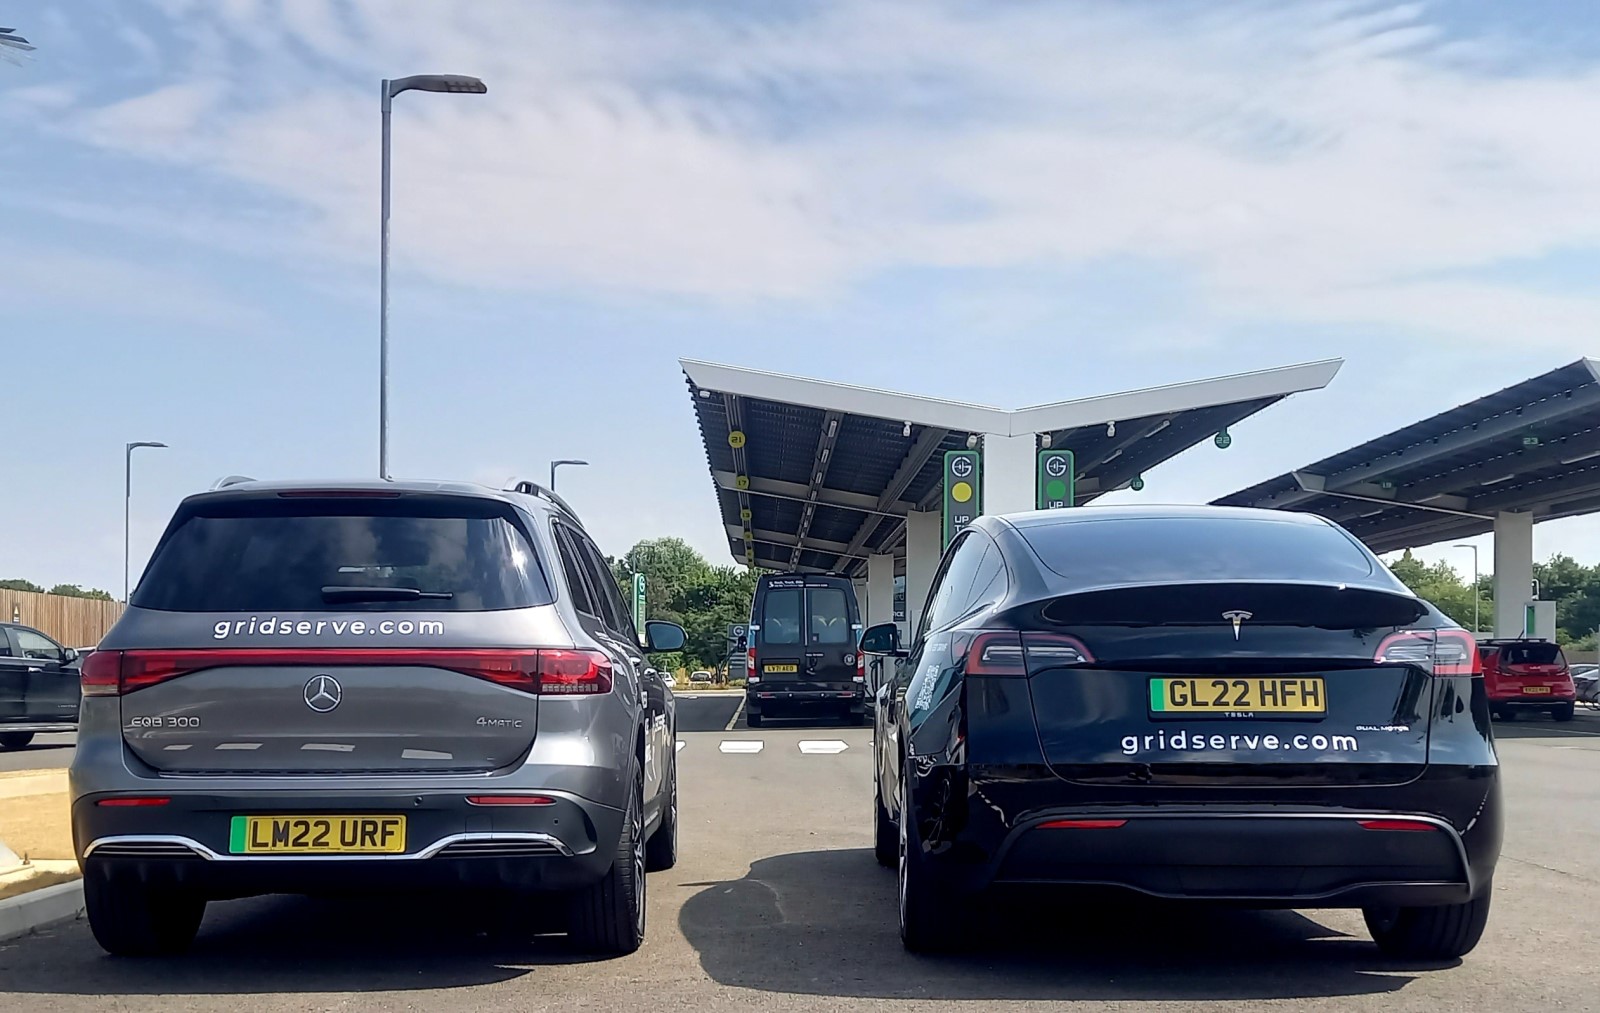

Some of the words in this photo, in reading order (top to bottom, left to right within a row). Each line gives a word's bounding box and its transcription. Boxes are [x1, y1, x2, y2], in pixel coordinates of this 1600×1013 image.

[1216, 436, 1230, 444] 22
[1523, 437, 1539, 445] 23
[1048, 501, 1063, 509] UP
[954, 515, 969, 524] UP
[213, 616, 445, 639] gridserve.com
[1169, 680, 1250, 707] GL22
[1259, 680, 1319, 707] HFH
[131, 717, 162, 727] EQB
[167, 717, 199, 727] 300
[476, 717, 522, 728] 4MATIC
[1121, 730, 1358, 754] gridserve.com
[251, 821, 330, 848] LM22
[339, 820, 399, 847] URF
